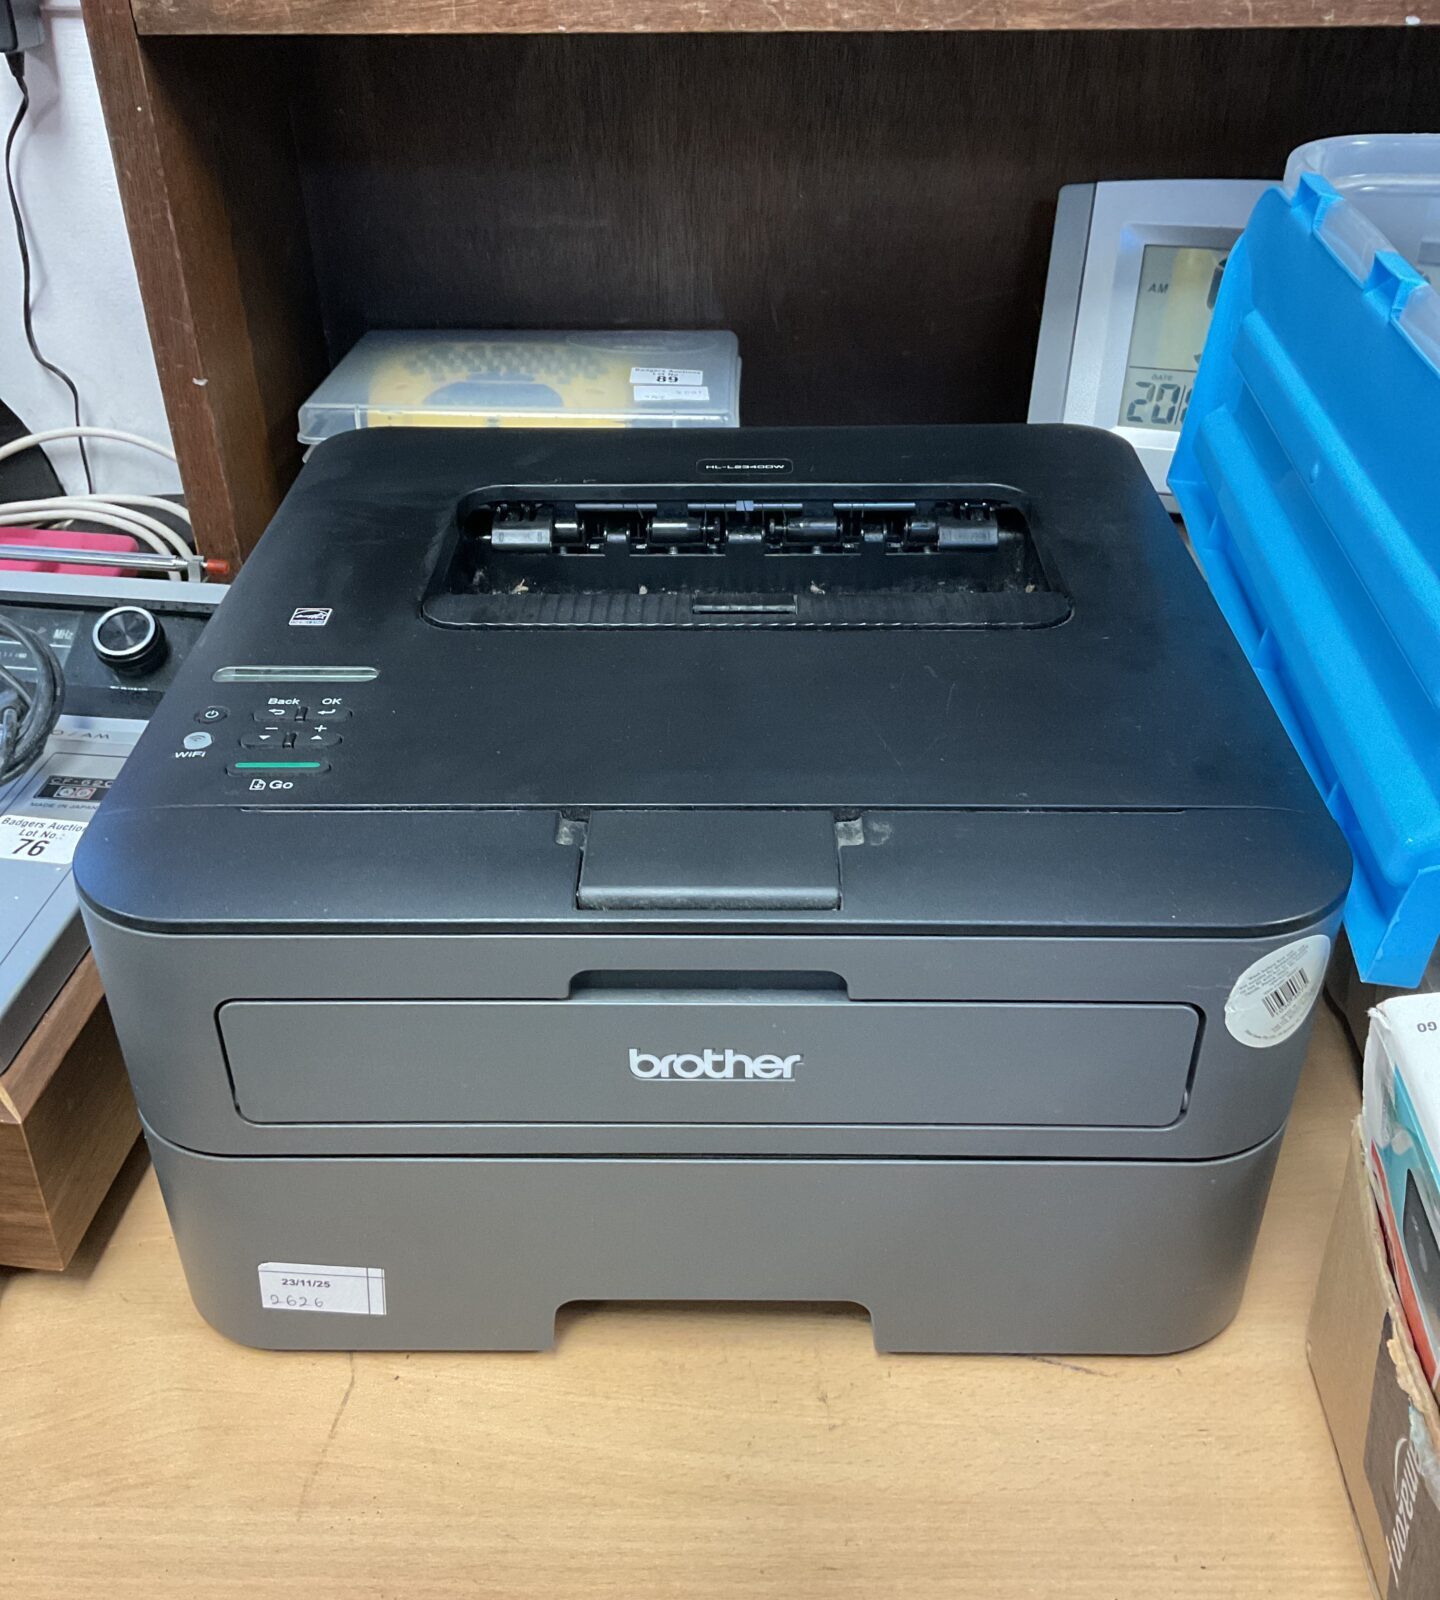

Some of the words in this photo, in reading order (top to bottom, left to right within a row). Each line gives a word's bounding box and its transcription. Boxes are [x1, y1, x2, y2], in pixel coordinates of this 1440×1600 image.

[1148, 284, 1169, 294] AM
[269, 780, 294, 790] Go
[1, 817, 46, 828] Badgers
[18, 828, 39, 837] Lot
[12, 838, 50, 857] 76
[628, 1048, 802, 1079] brother
[281, 1278, 331, 1289] 23/11/25
